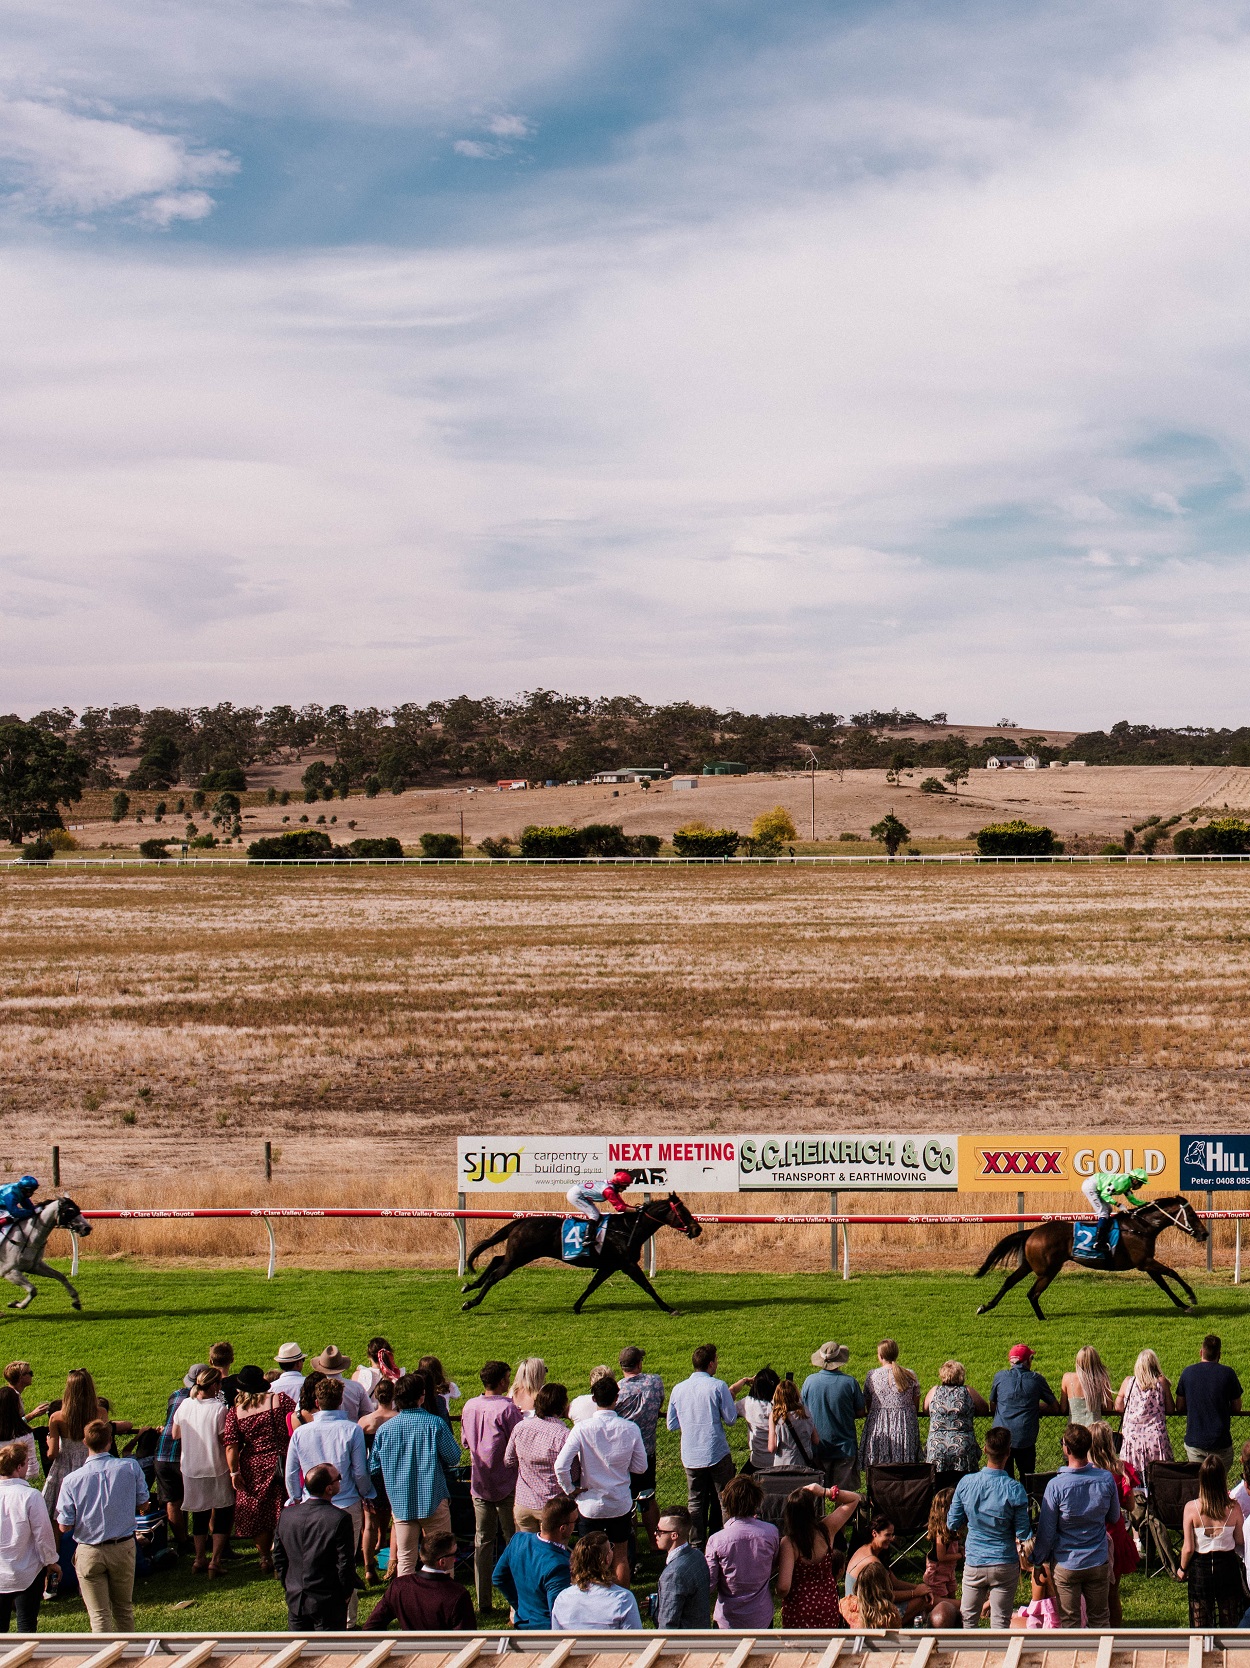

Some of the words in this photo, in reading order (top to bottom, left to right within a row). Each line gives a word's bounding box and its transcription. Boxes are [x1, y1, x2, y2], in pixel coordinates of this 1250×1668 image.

[534, 1152, 588, 1163] carpentry
[608, 1144, 652, 1161] NEXT
[658, 1142, 734, 1161] MEETING
[901, 1140, 920, 1168] &
[463, 1146, 520, 1182] sjm
[534, 1164, 580, 1176] building
[981, 1151, 1062, 1174] XXXX
[1072, 1149, 1166, 1176] GOLD
[772, 1172, 835, 1182] TRANSPORT
[838, 1172, 846, 1182] &
[850, 1172, 926, 1182] EARTHMOVING
[565, 1226, 582, 1248] 4
[1076, 1230, 1092, 1251] 2
